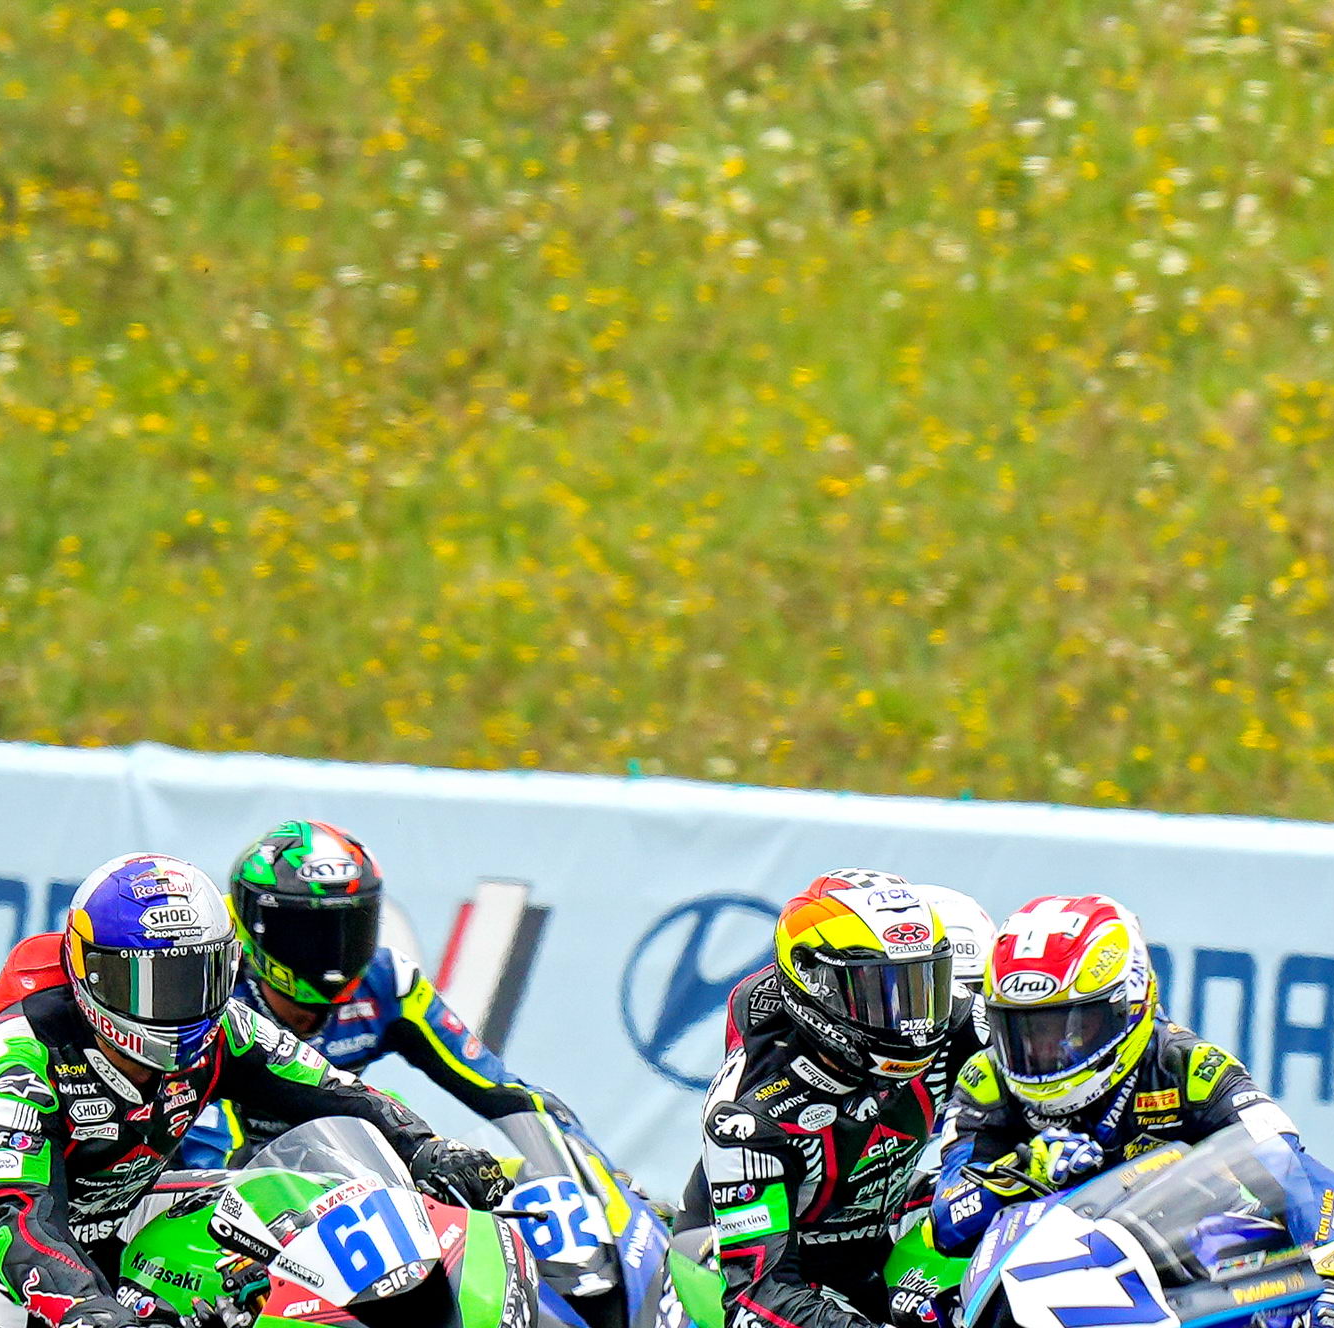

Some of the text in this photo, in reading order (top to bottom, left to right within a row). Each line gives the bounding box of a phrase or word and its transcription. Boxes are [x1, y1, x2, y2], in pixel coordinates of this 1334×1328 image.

[301, 863, 358, 879] KYT
[133, 880, 194, 899] Red Bull
[149, 908, 193, 925] SHOEI
[120, 942, 227, 960] GIVES YOU WINGS
[1005, 971, 1053, 995] Arai
[780, 985, 849, 1045] Kabuto
[99, 1014, 144, 1055] Bull
[754, 1077, 791, 1102] ARROW
[76, 1103, 110, 1118] SHOEI
[712, 1185, 738, 1204] elf
[512, 1181, 601, 1260] 62
[317, 1188, 422, 1294] 61
[130, 1251, 203, 1293] Kawasaki
[373, 1266, 410, 1299] elf
[1006, 1230, 1170, 1328] 77
[116, 1285, 138, 1308] elf
[282, 1299, 322, 1317] GIVI
[890, 1290, 925, 1312] elf
